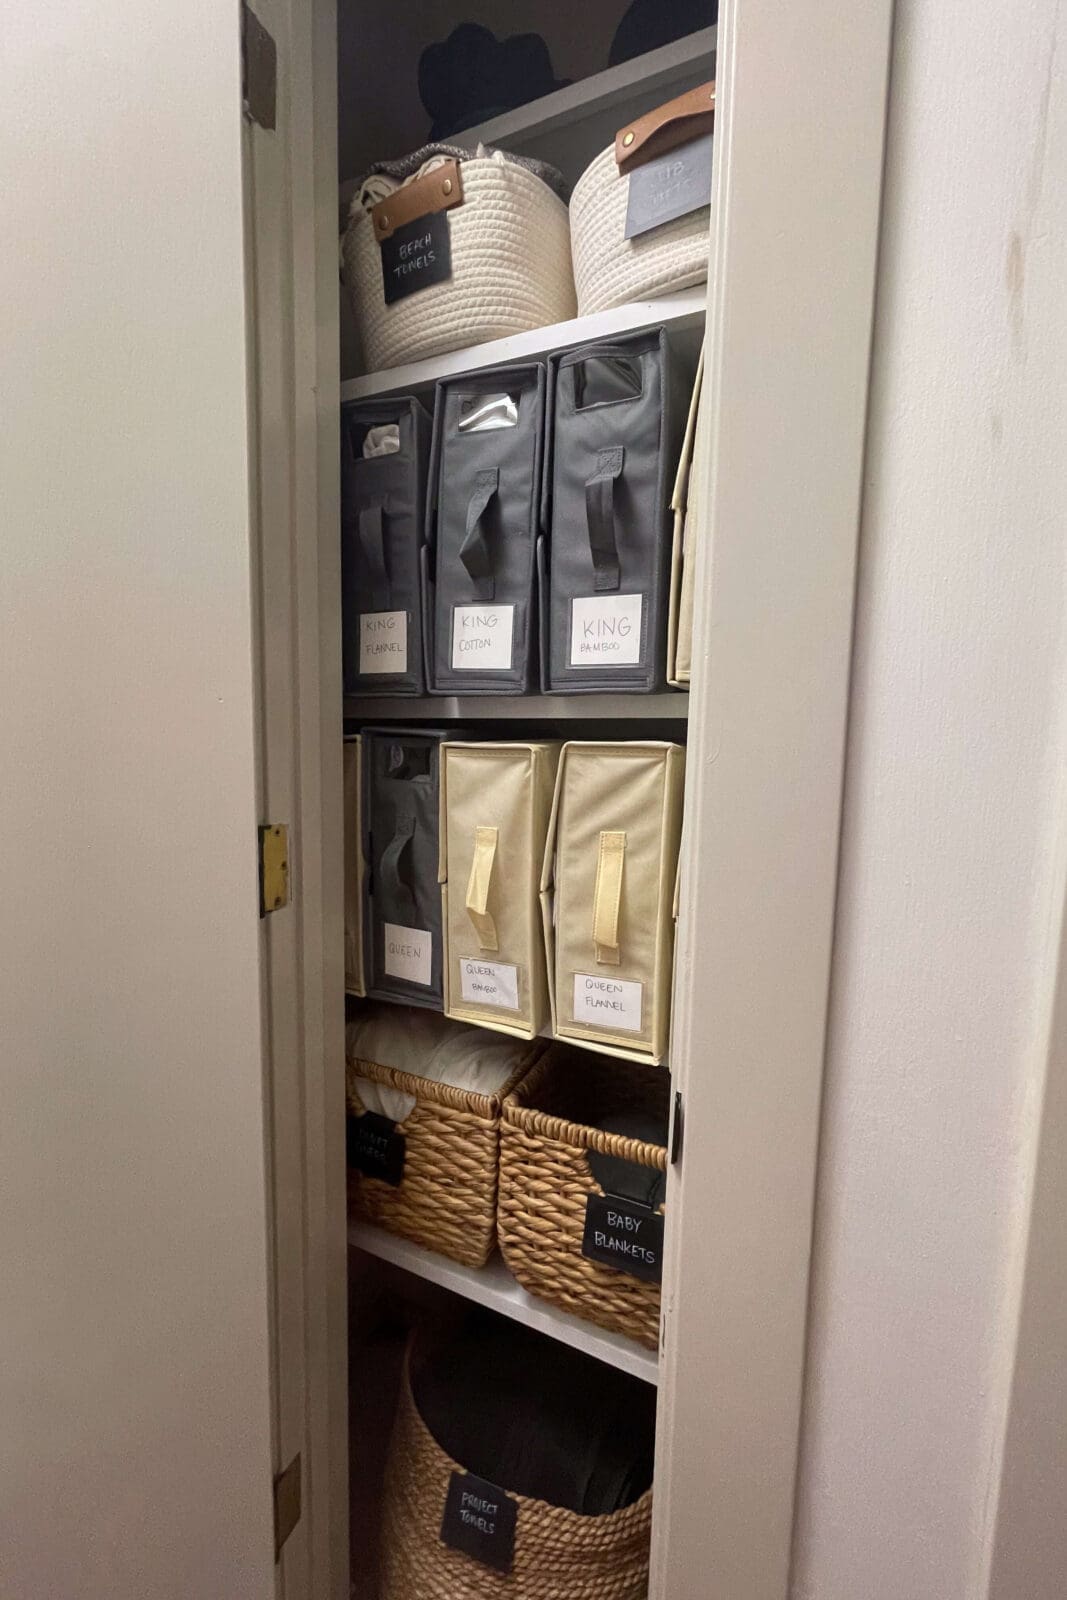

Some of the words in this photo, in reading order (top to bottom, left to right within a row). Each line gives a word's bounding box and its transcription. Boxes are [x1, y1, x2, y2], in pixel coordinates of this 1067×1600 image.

[400, 233, 431, 260] BEACH
[366, 617, 395, 631] KING
[462, 614, 498, 628] KING
[584, 617, 631, 638] KING
[366, 643, 405, 655] FLANNEL
[459, 638, 491, 652] COTTON
[580, 642, 620, 652] BAMBOO
[389, 942, 421, 958] QUEEN
[466, 964, 495, 977] QUEEN
[586, 979, 623, 993] QUEEN
[585, 996, 626, 1012] FLANNEL
[607, 1211, 642, 1233] BABY
[595, 1231, 655, 1263] BLANKETS
[461, 1491, 498, 1514] PROJECT
[460, 1509, 495, 1534] TOWELS
